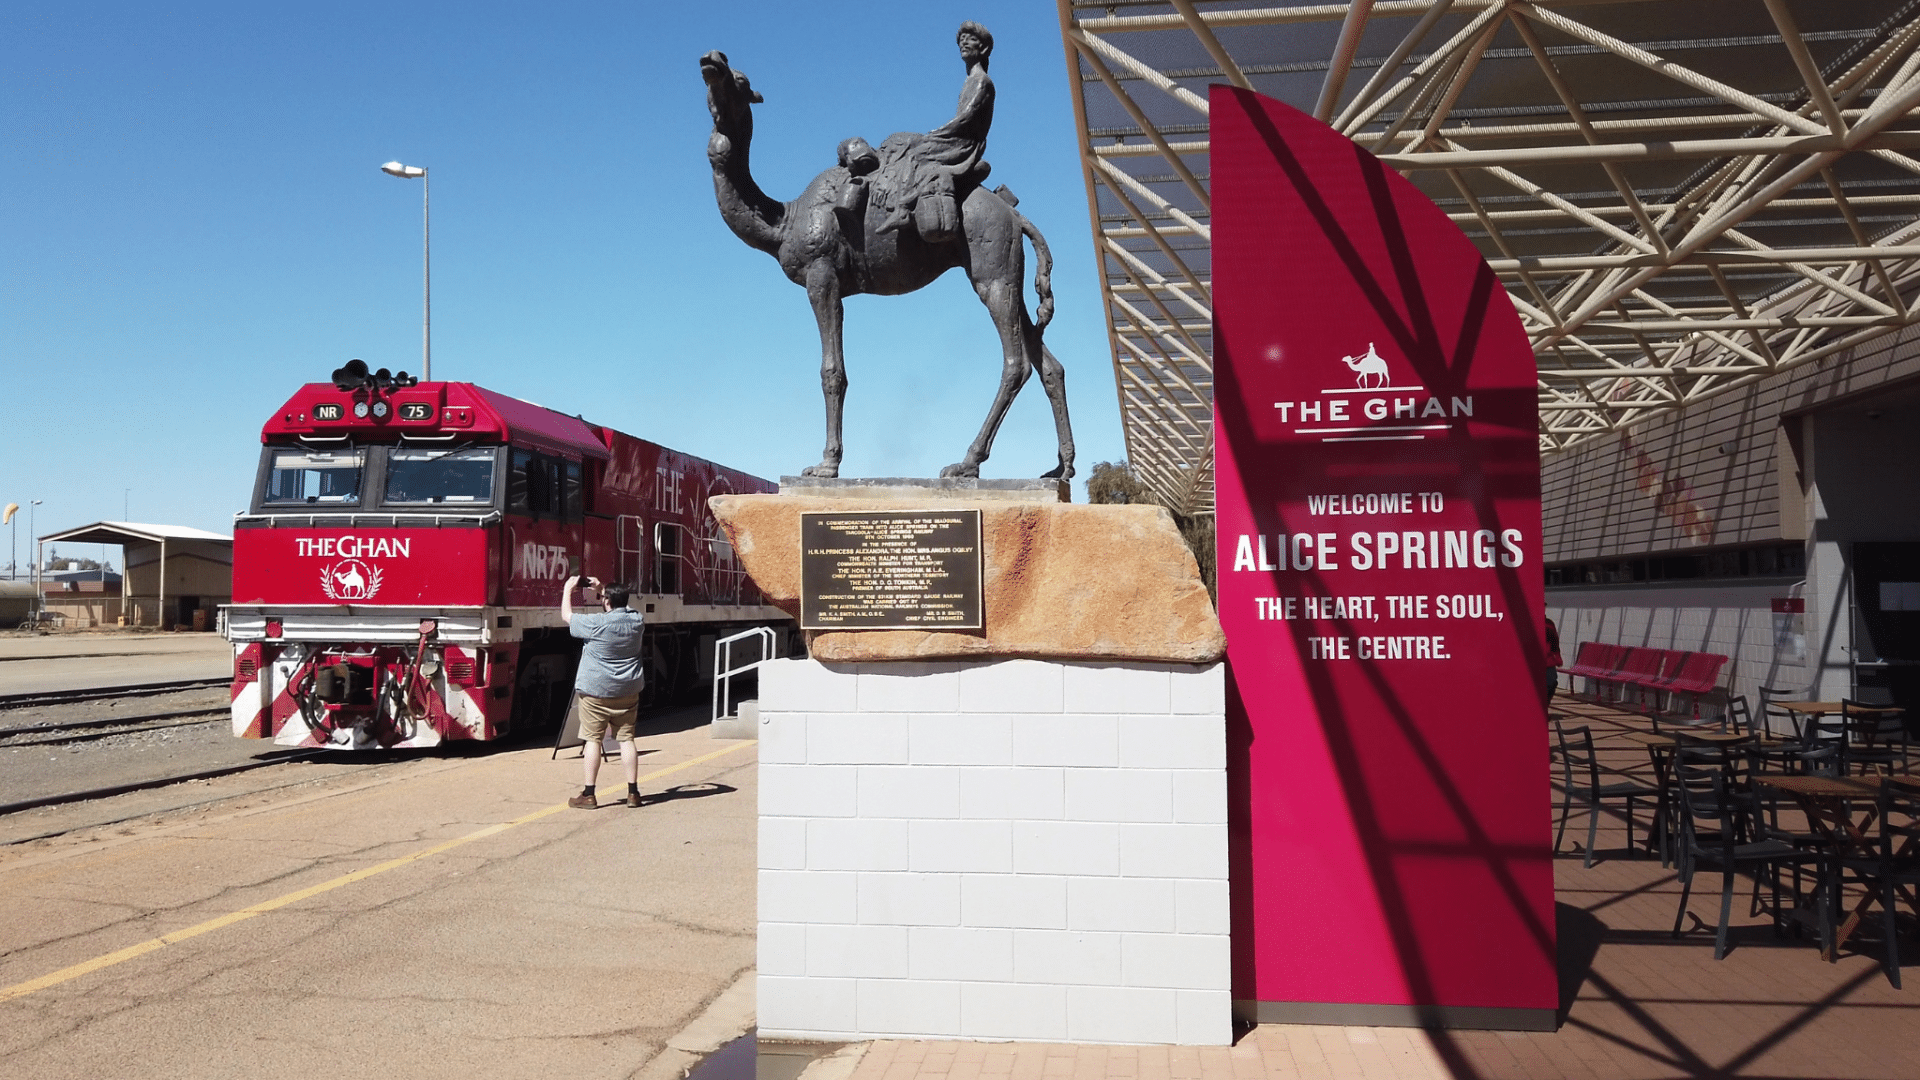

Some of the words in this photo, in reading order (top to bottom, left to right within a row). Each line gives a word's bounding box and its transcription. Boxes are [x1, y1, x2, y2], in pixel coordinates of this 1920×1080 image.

[319, 406, 337, 418] NR
[407, 405, 424, 417] 75
[1274, 399, 1350, 423] THE
[1363, 395, 1474, 421] GHAN
[1308, 492, 1413, 516] WELCOME
[1418, 491, 1444, 514] TO
[522, 543, 567, 580] NR75
[1233, 532, 1339, 572] ALICE
[1350, 528, 1524, 571] SPRINGS
[1254, 596, 1297, 621] THE
[1304, 595, 1379, 623] HEART,
[1385, 595, 1429, 619] THE
[1435, 594, 1504, 622] SOUL,
[1308, 636, 1350, 660] THE
[1358, 635, 1451, 660] CENTRE.
